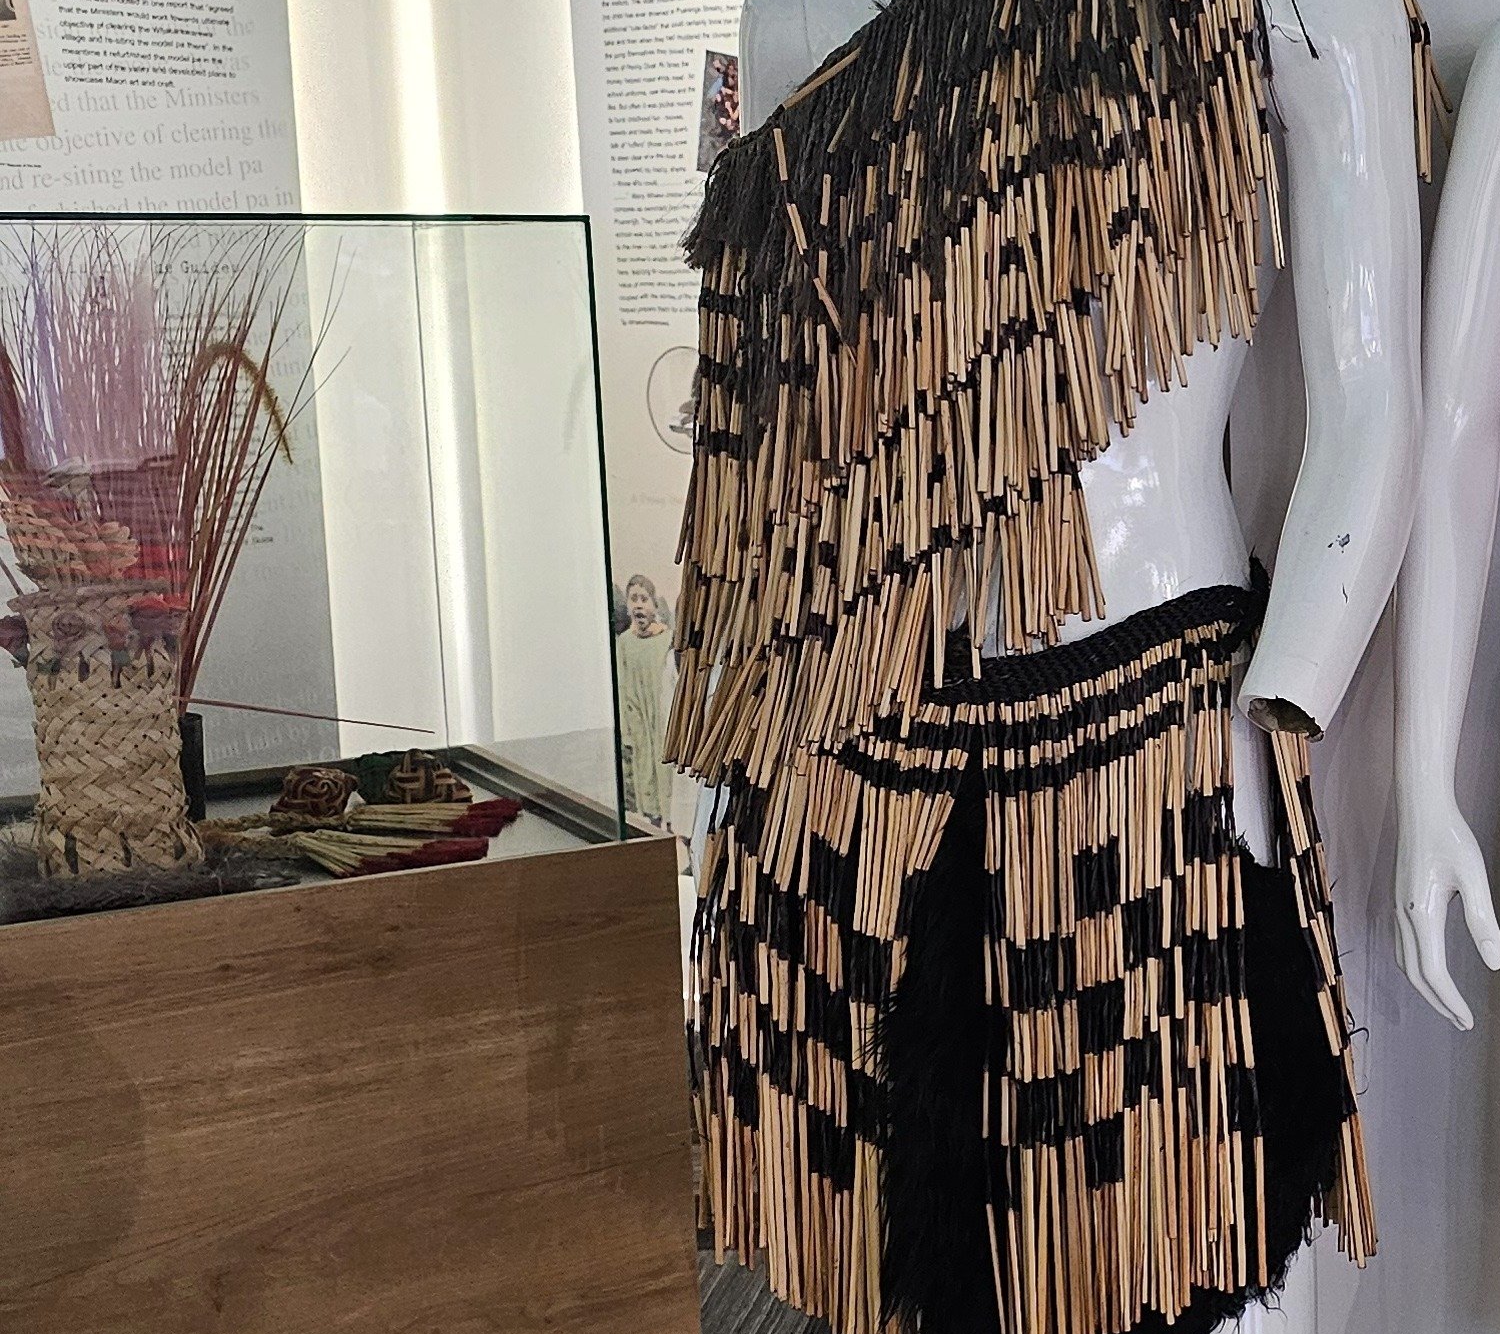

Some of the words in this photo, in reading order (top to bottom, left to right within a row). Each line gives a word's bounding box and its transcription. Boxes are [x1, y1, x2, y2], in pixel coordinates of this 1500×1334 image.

[76, 93, 120, 113] that
[126, 91, 158, 111] the
[164, 87, 260, 109] Ministers
[142, 123, 164, 145] of
[170, 121, 252, 147] clearing
[258, 119, 288, 139] the
[0, 169, 24, 191] nd
[32, 163, 124, 189] re-siting
[130, 161, 162, 183] the
[170, 155, 232, 181] model
[238, 157, 264, 181] pa
